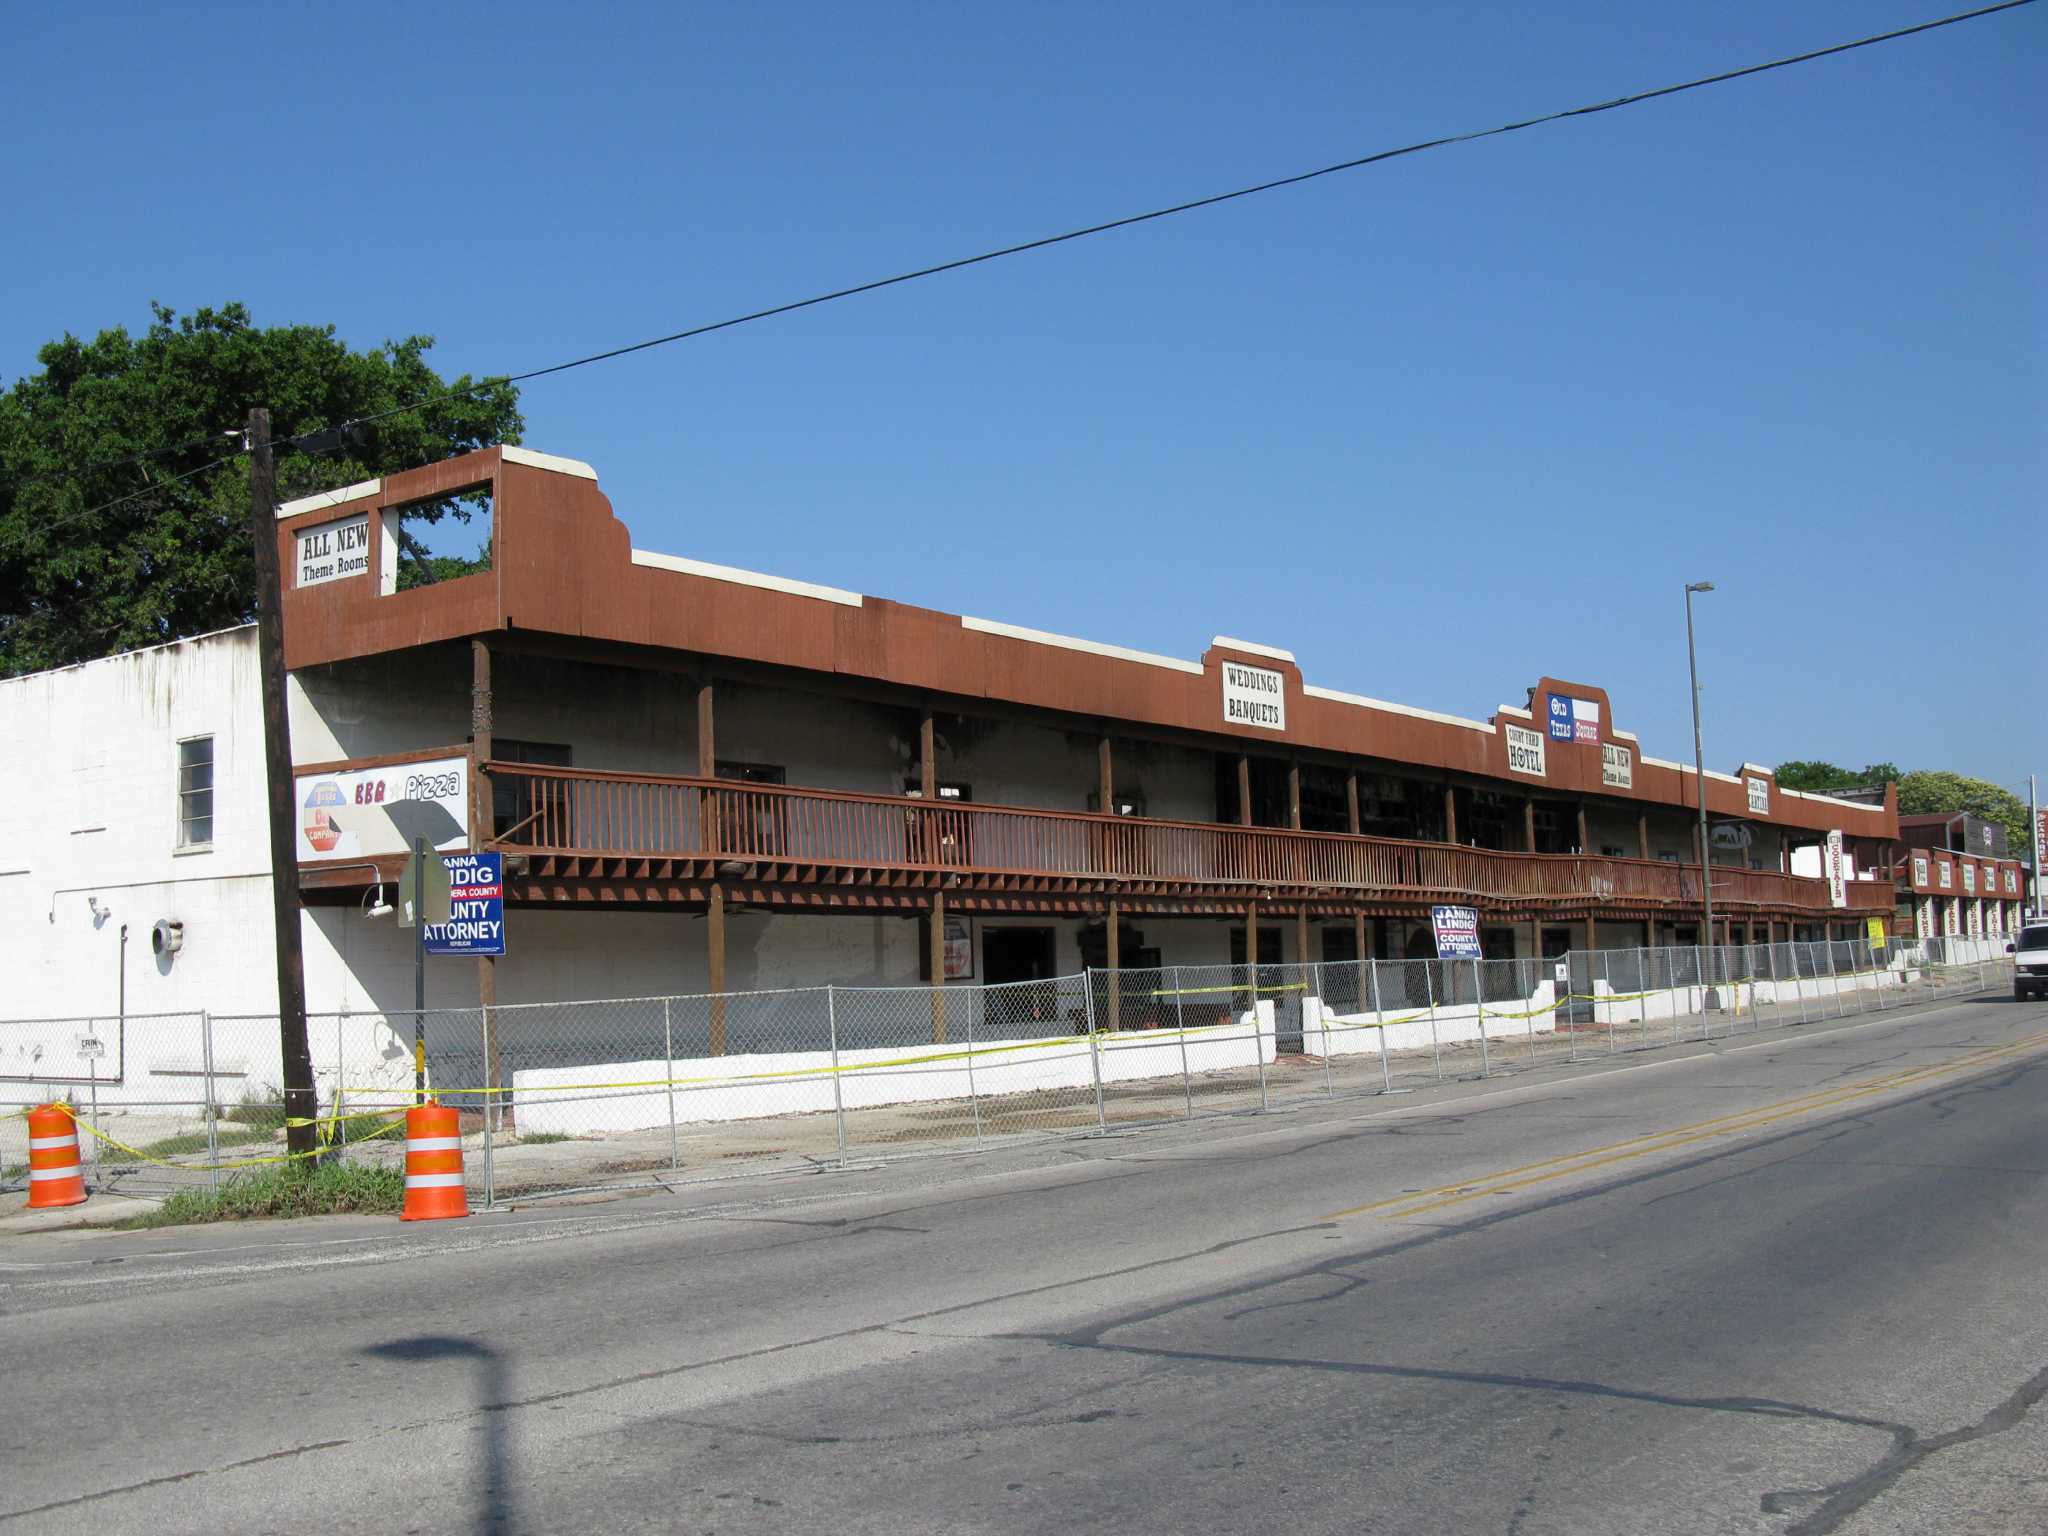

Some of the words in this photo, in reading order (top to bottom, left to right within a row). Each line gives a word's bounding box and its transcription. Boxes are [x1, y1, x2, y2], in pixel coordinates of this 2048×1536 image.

[303, 532, 331, 560] ALL
[337, 522, 369, 552] NEW
[303, 564, 334, 581] Theme
[338, 556, 369, 574] Rooms
[1227, 667, 1278, 693] WEDDINGS
[1229, 698, 1279, 724] BANQUETS
[1551, 698, 1567, 716] OLD
[1550, 720, 1571, 738] TEXAS
[1509, 745, 1541, 772] HOTEL
[1603, 746, 1616, 765] ALL
[405, 771, 460, 801] Pizza
[443, 856, 478, 868] ANNA
[469, 886, 498, 897] COUNTY
[450, 901, 489, 920] UNTY
[1435, 909, 1475, 920] JANNA
[424, 921, 500, 940] ATTORNEY
[1437, 920, 1474, 929] LINDIG
[1440, 934, 1474, 943] COUNTY
